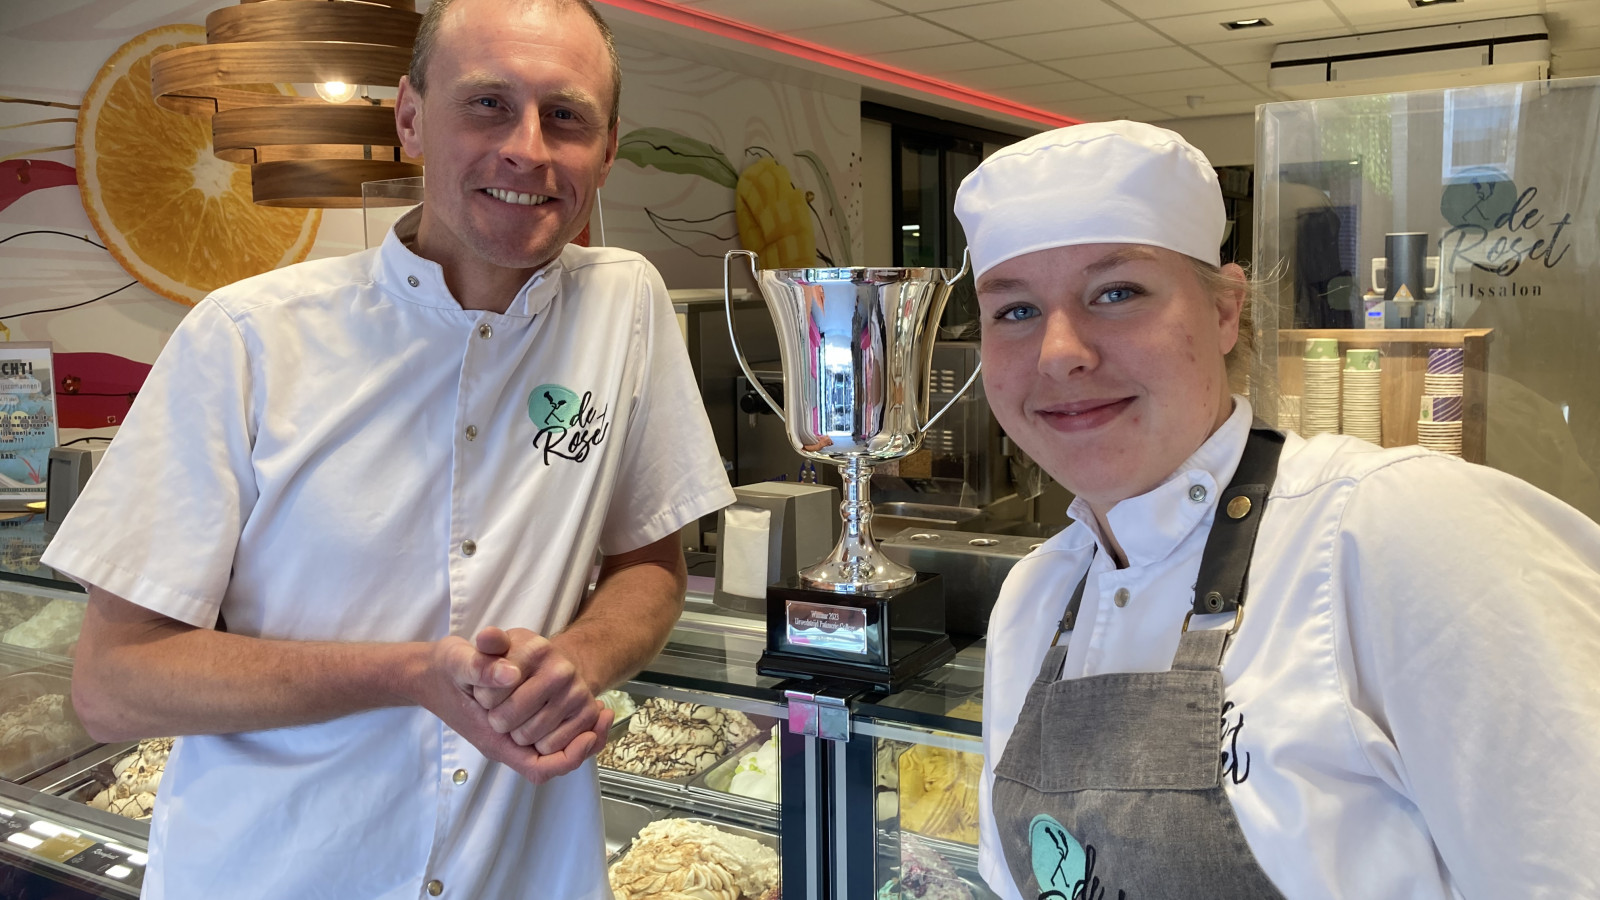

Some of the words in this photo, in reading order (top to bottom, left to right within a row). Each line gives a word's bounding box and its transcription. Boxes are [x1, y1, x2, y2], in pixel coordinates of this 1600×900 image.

[1494, 186, 1544, 232] de
[1438, 212, 1571, 277] Roset
[532, 402, 609, 466] Roset
[569, 390, 597, 428] de
